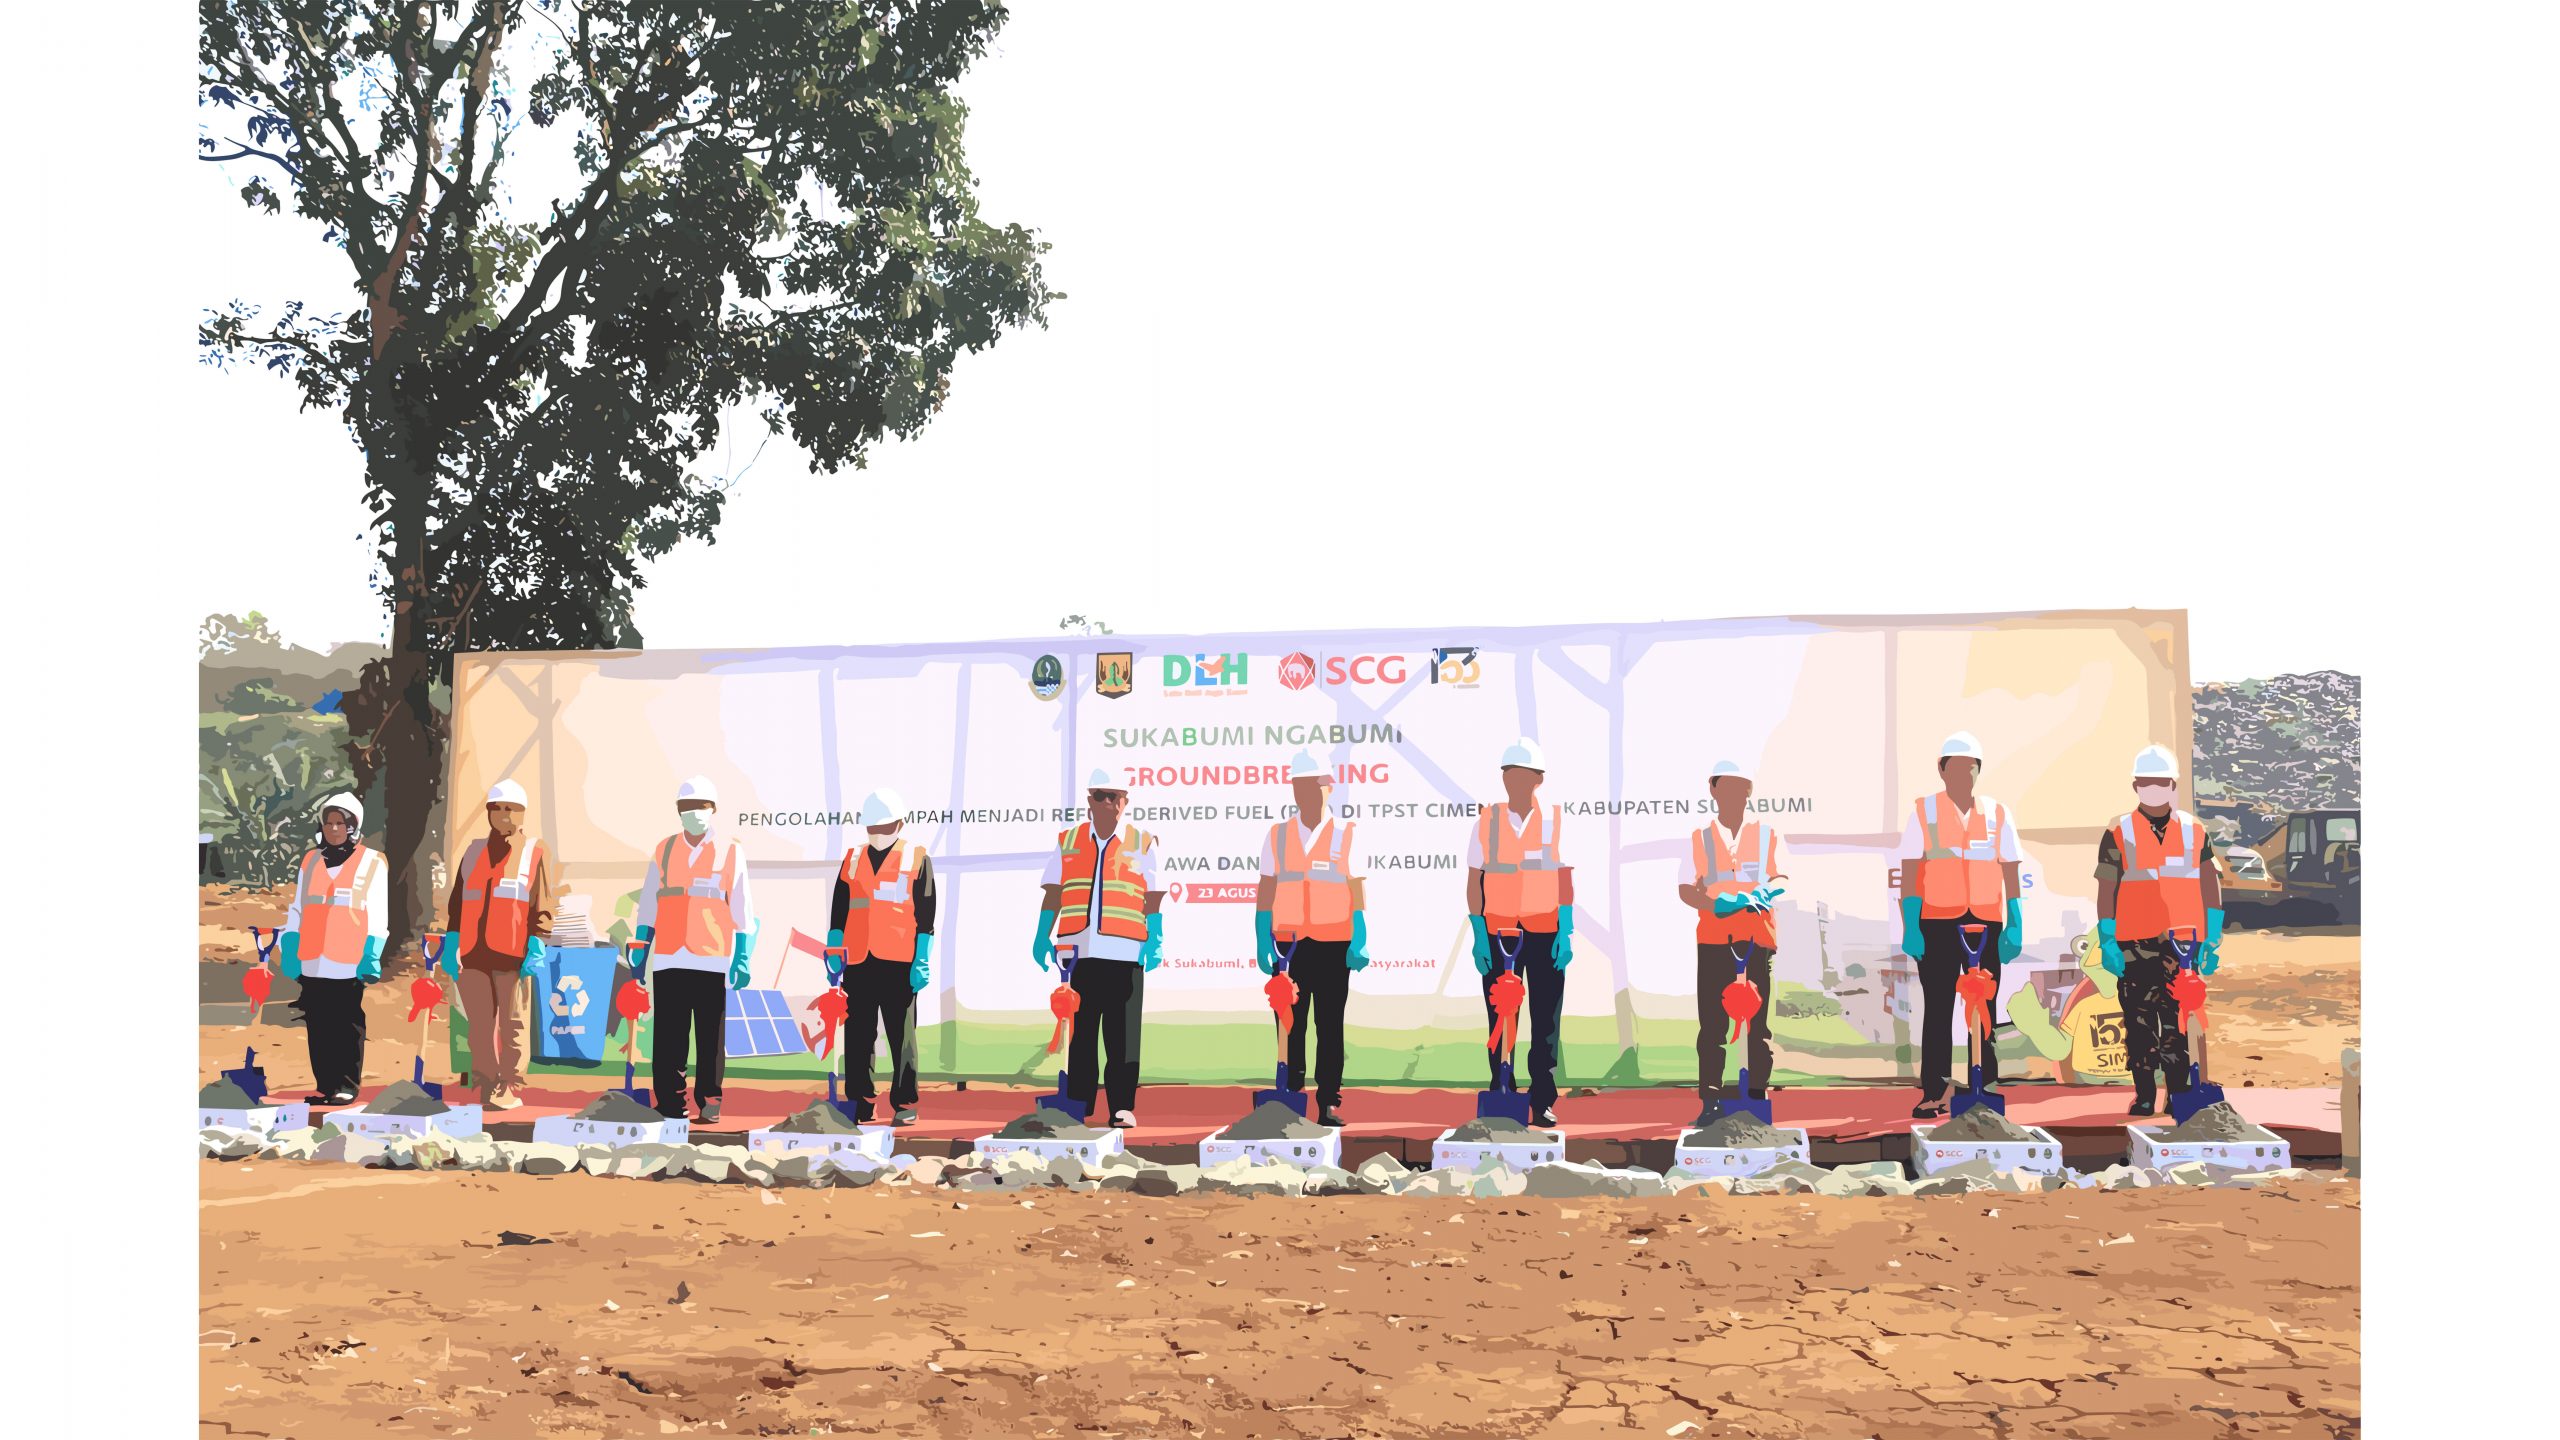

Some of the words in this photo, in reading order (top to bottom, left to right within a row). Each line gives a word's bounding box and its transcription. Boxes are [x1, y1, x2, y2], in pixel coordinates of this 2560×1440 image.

[1163, 653, 1248, 687] DLH
[1326, 655, 1406, 686] SCG
[1104, 725, 1254, 748] SUKABUMI
[1264, 723, 1403, 745] NGABUMI
[904, 809, 953, 824] MPAH
[960, 808, 1045, 823] MENJADI
[1225, 804, 1274, 820] FUEL
[1341, 804, 1361, 819] DI
[1368, 803, 1418, 818] TPST
[1563, 799, 1689, 816] KABUPATEN
[1696, 797, 1813, 815] SUABUMI
[1164, 856, 1211, 871] AWA
[1217, 855, 1260, 871] DAN
[1217, 886, 1257, 898] AGUS
[1369, 958, 1436, 972] asyarakat
